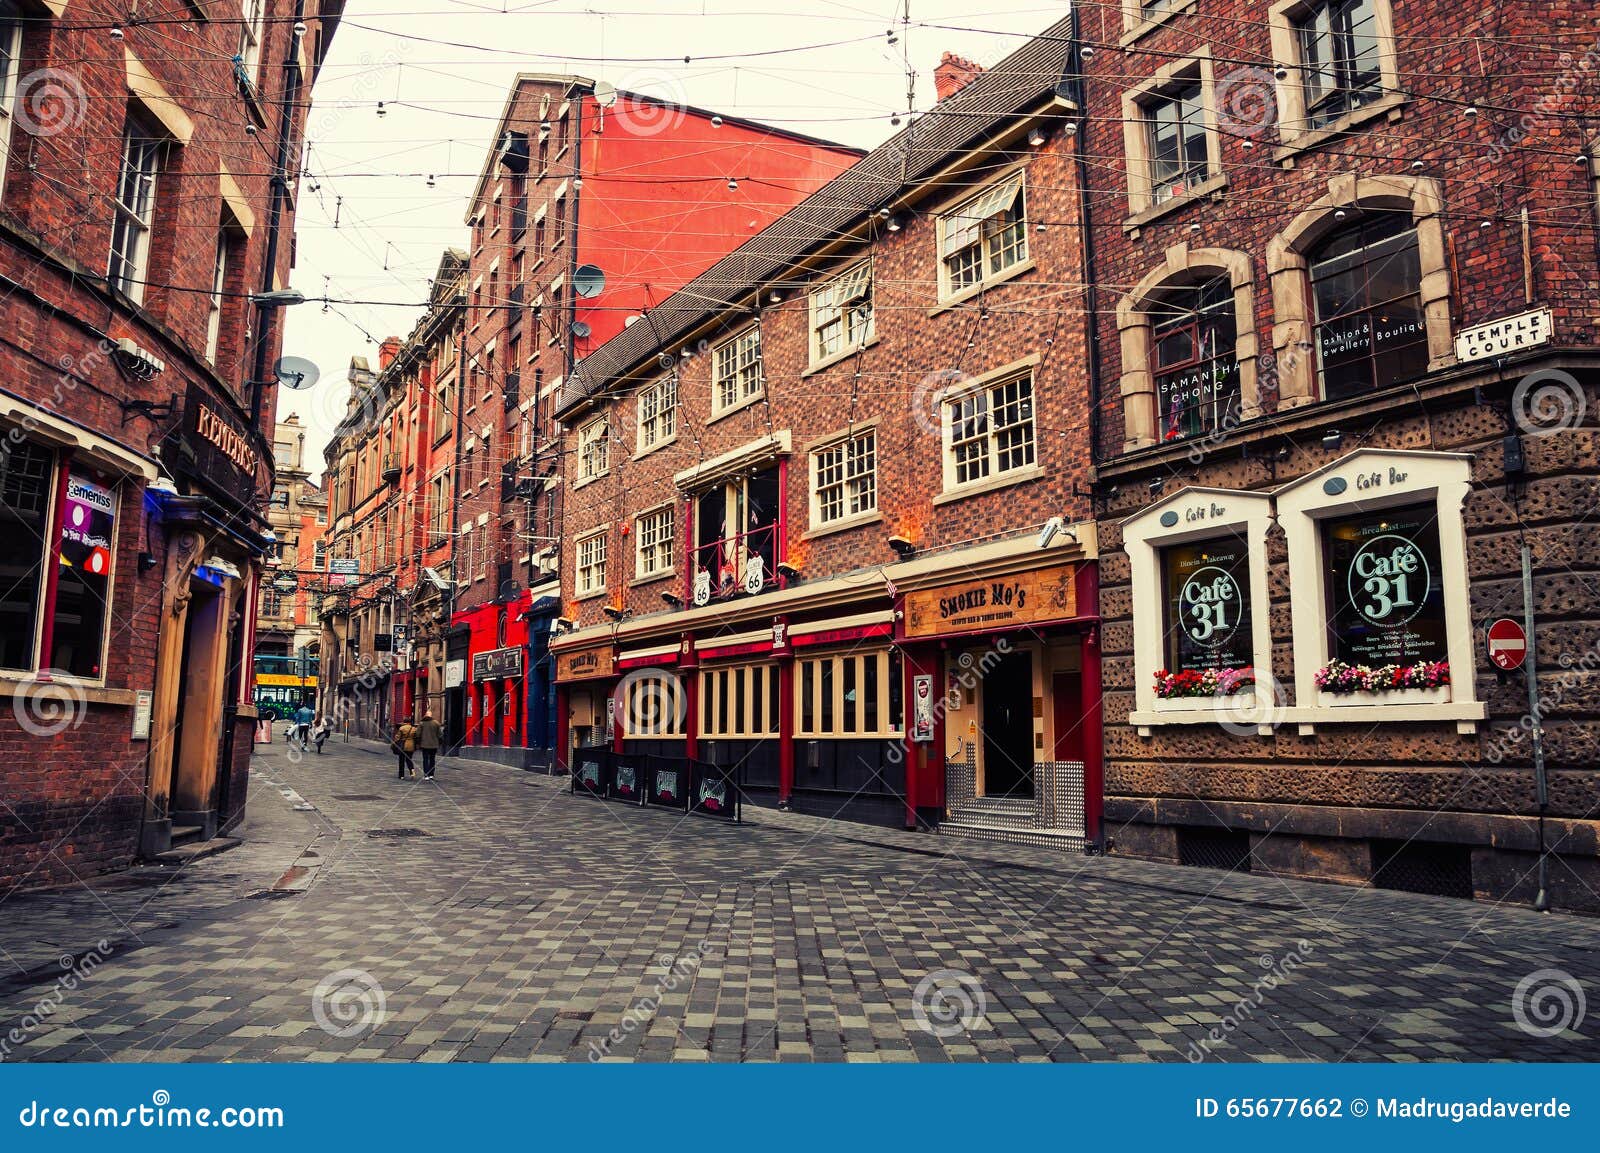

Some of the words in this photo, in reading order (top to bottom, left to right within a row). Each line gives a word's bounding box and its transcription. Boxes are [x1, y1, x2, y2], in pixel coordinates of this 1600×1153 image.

[1323, 338, 1370, 357] ewellery
[1377, 321, 1424, 341] Boutiqu
[1324, 329, 1360, 345] ashion
[1363, 324, 1369, 333] &
[1465, 316, 1539, 344] TEMPLE
[1469, 330, 1538, 356] COURT
[1161, 361, 1240, 393] SAMANTHA
[1171, 381, 1223, 403] CHONG
[1389, 467, 1408, 484] Bar
[1211, 503, 1226, 518] Bar
[1356, 545, 1418, 578] Café
[698, 587, 707, 600] 66
[749, 574, 760, 588] 66
[1185, 575, 1233, 604] Café
[940, 588, 986, 618] SMOKIE
[1364, 574, 1414, 619] 31
[1191, 601, 1230, 640] 31
